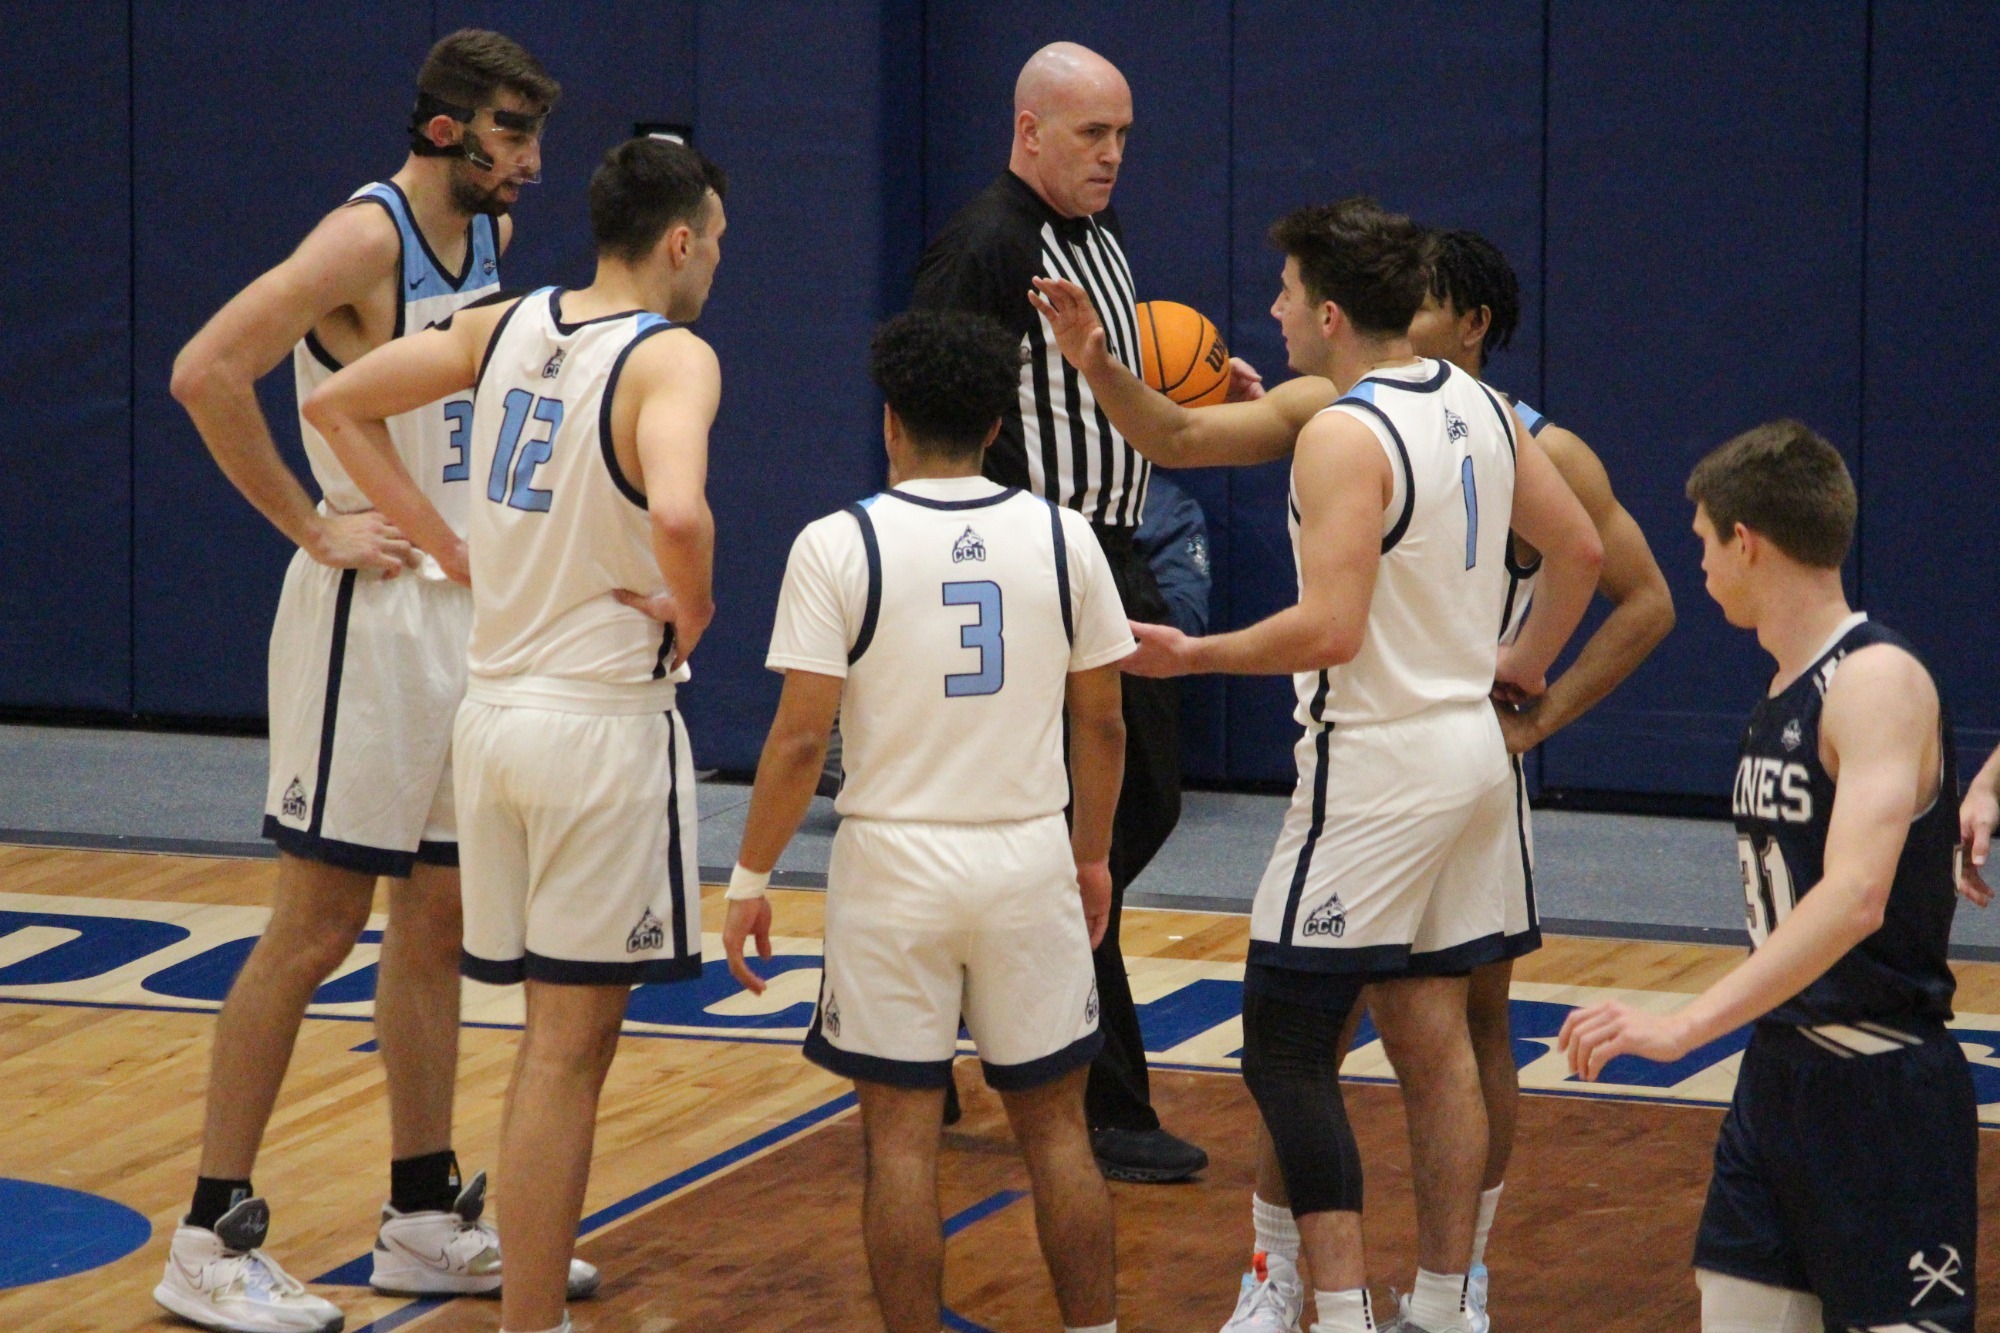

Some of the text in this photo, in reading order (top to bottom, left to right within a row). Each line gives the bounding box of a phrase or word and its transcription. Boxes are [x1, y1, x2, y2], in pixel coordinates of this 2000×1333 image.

[487, 388, 564, 512] 12
[1461, 455, 1478, 571] 1
[952, 547, 986, 564] CCU
[942, 580, 1004, 697] 3
[626, 929, 664, 953] CCU
[1303, 917, 1345, 938] CCU
